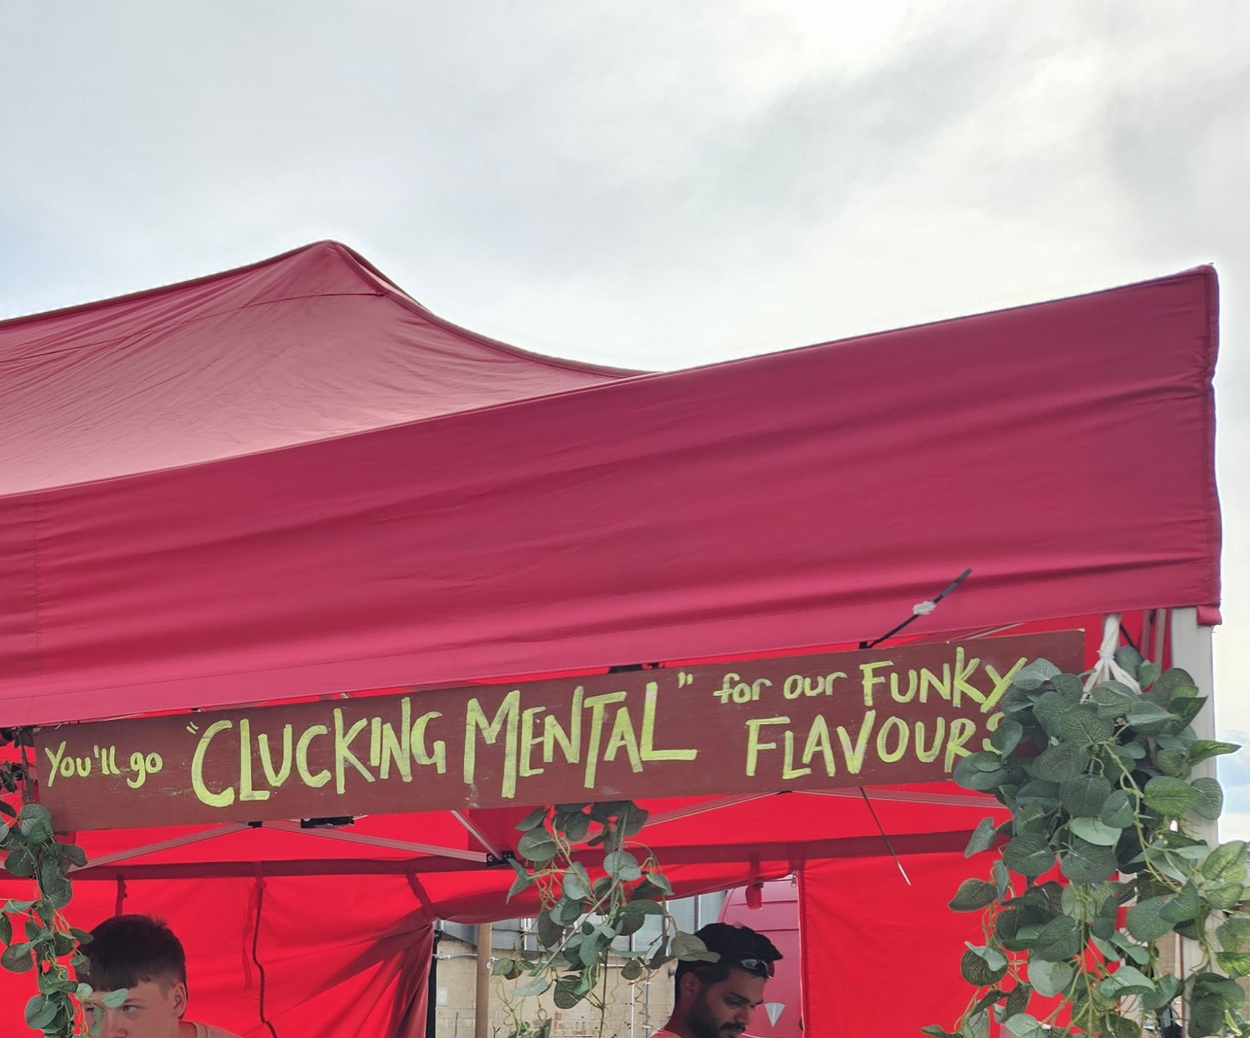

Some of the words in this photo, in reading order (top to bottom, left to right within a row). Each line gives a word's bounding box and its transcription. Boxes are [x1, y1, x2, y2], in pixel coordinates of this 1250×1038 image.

[45, 741, 120, 787] You'll
[127, 751, 163, 789] go
[713, 672, 773, 705] for
[783, 671, 847, 700] our
[859, 646, 1028, 713] FUNKY
